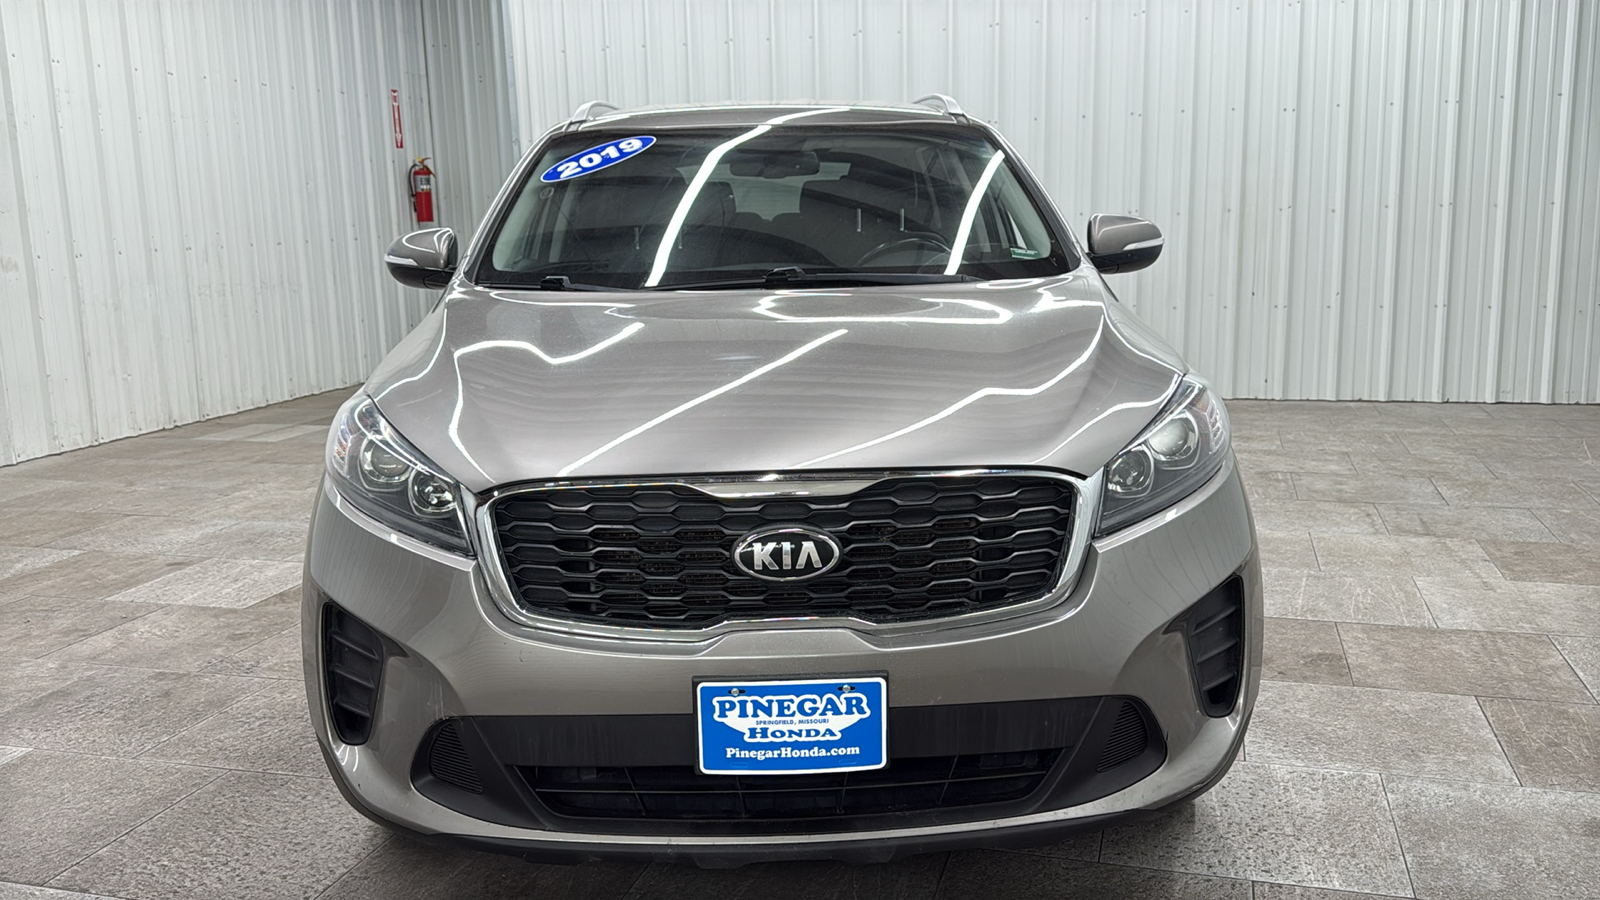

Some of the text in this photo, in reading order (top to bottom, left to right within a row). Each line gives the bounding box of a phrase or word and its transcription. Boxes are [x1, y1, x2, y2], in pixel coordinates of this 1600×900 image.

[556, 138, 643, 179] 2019
[752, 540, 823, 570] KIA
[716, 695, 868, 719] PINEGAR
[747, 726, 838, 739] HONDA
[725, 746, 861, 761] PinegarHonda.com
